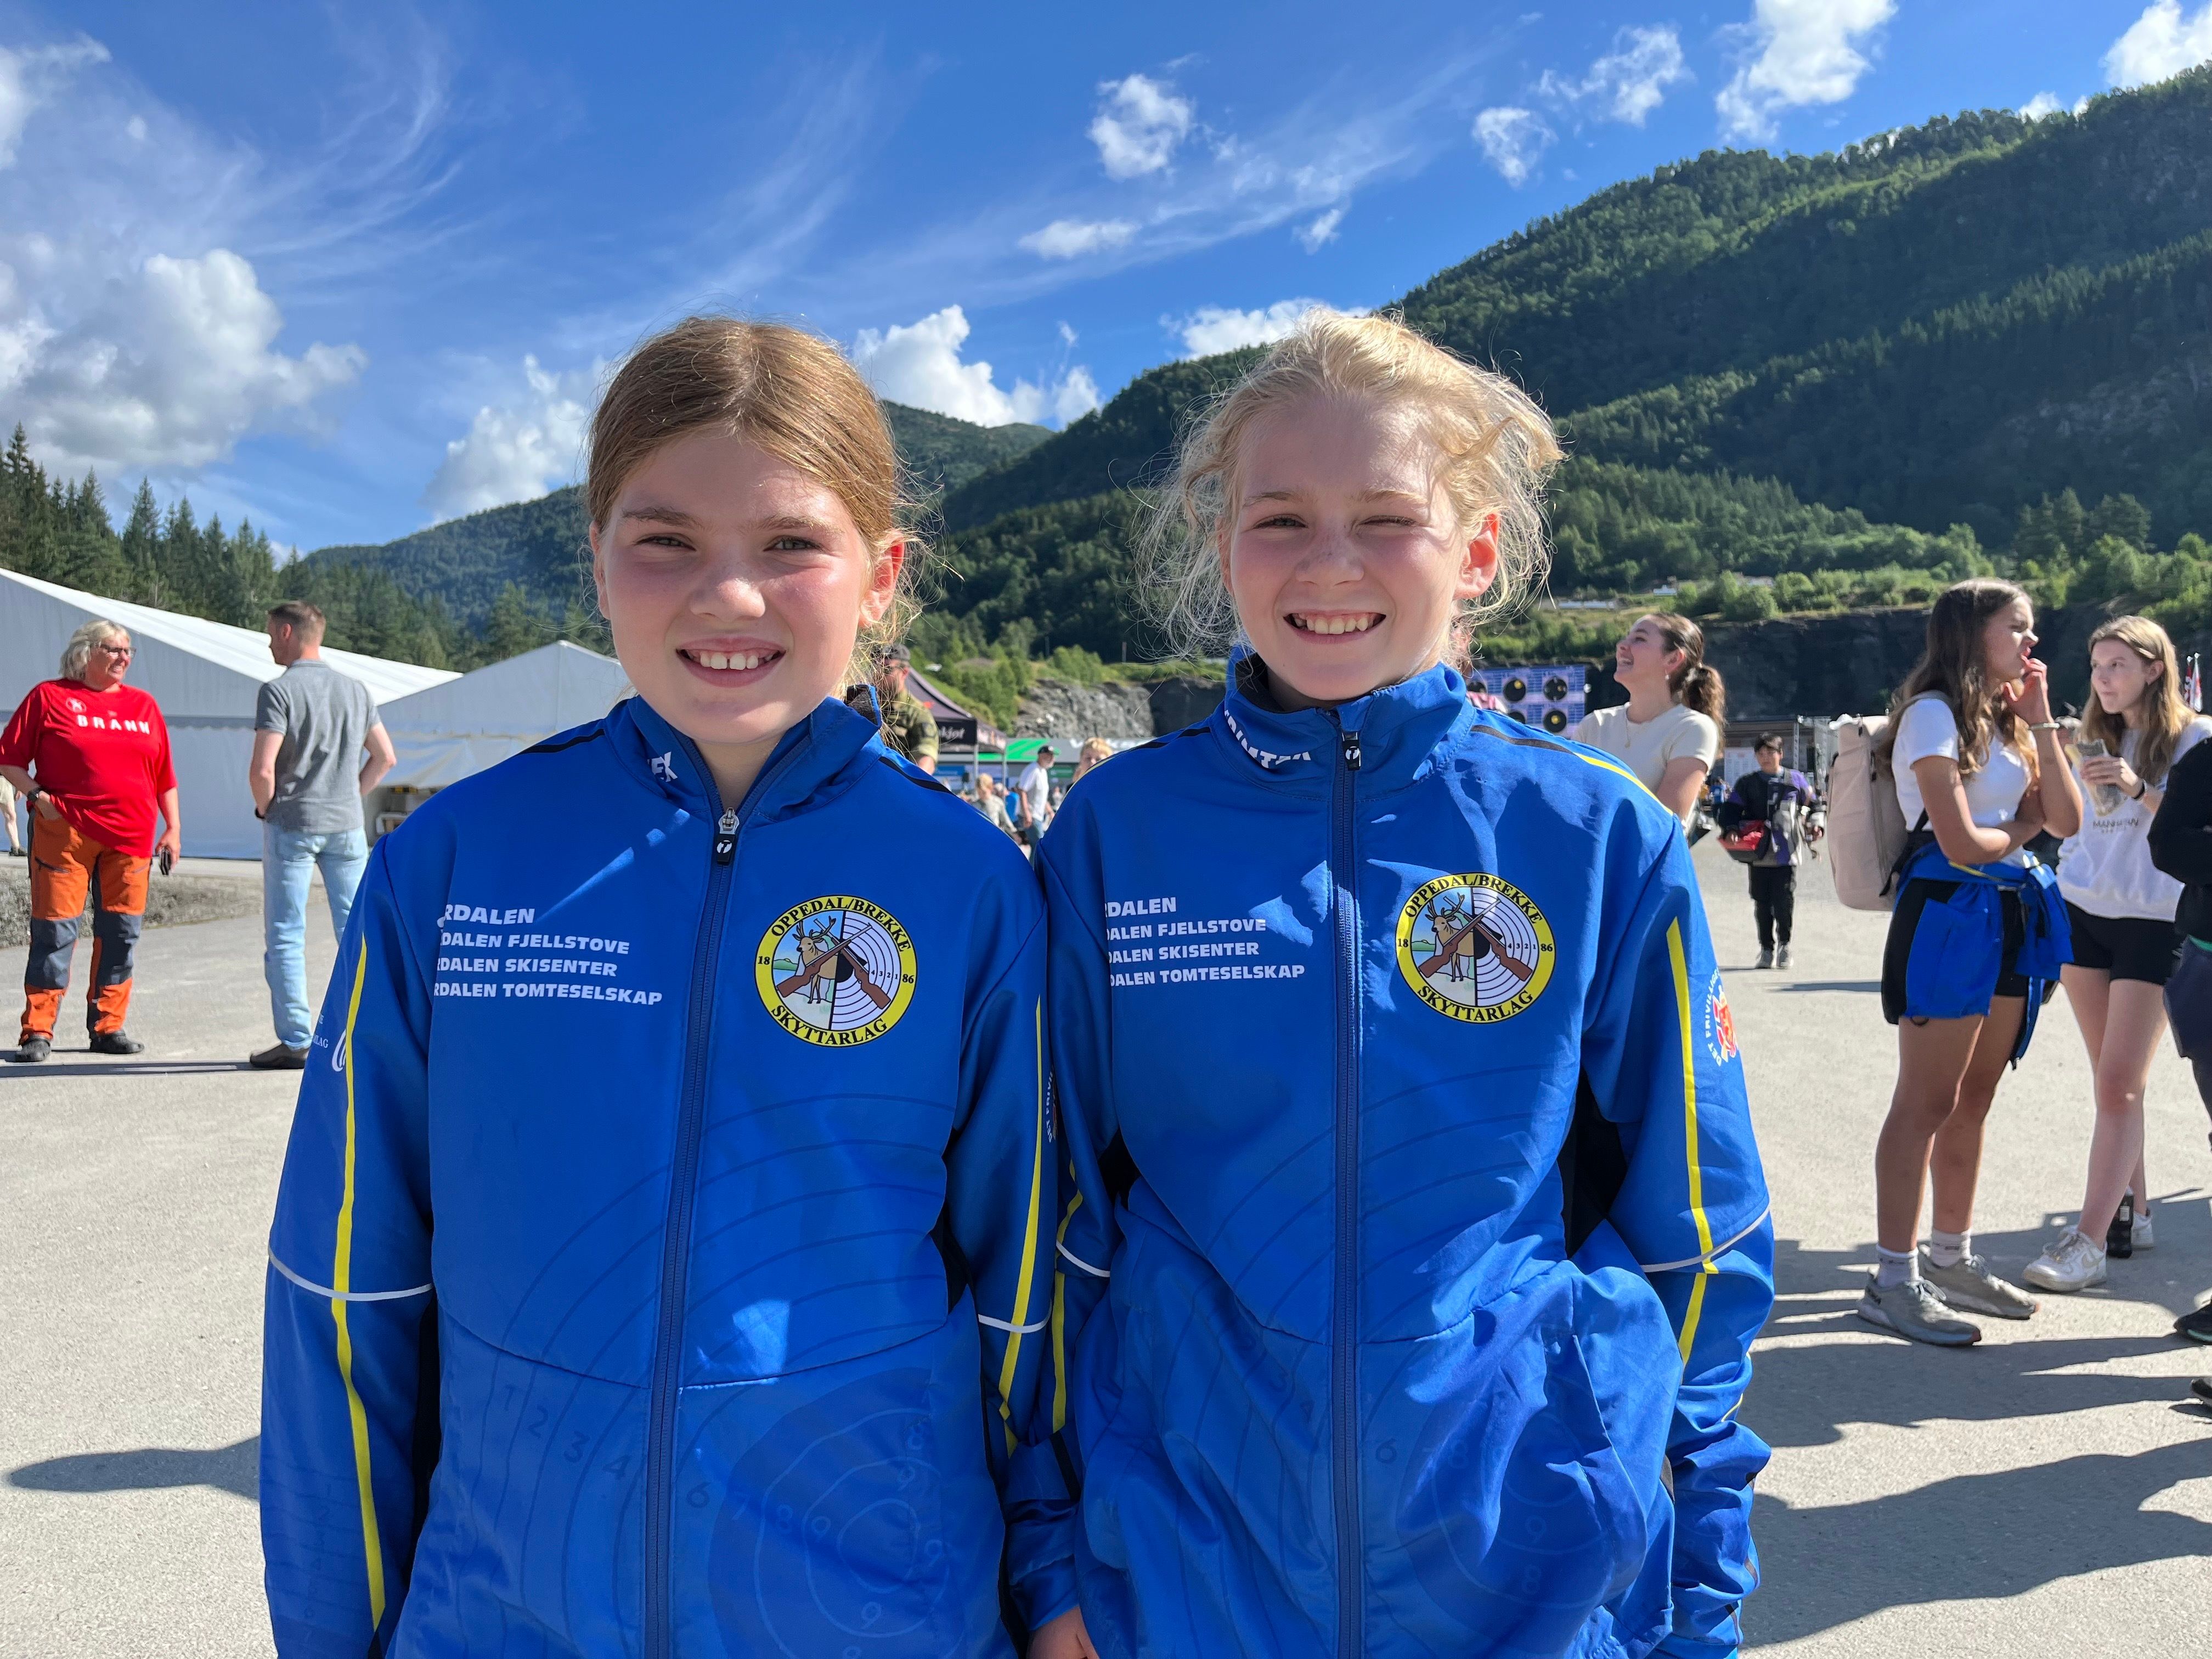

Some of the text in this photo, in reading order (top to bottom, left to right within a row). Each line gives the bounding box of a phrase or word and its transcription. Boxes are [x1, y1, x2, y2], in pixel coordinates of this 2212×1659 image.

[77, 714, 150, 735] BRANN
[1405, 875, 1544, 924] OPPEDAL/BREKKE
[771, 898, 911, 952] OPPEDAL/BREKKE
[1158, 919, 1266, 936] FJELLSTOVE
[509, 935, 629, 954] FJELLSTOVE
[1159, 943, 1259, 960] SKISENTER
[1398, 939, 1409, 947] 18
[506, 959, 617, 976] SKISENTER
[758, 956, 770, 965] 18
[902, 974, 914, 984] 86
[1160, 965, 1305, 983] TOMTESELSKAP
[503, 984, 662, 1005] TOMTESELSKAP
[1418, 986, 1533, 1022] SKYTTARLAG
[771, 1005, 888, 1045] SKYTTARLAG
